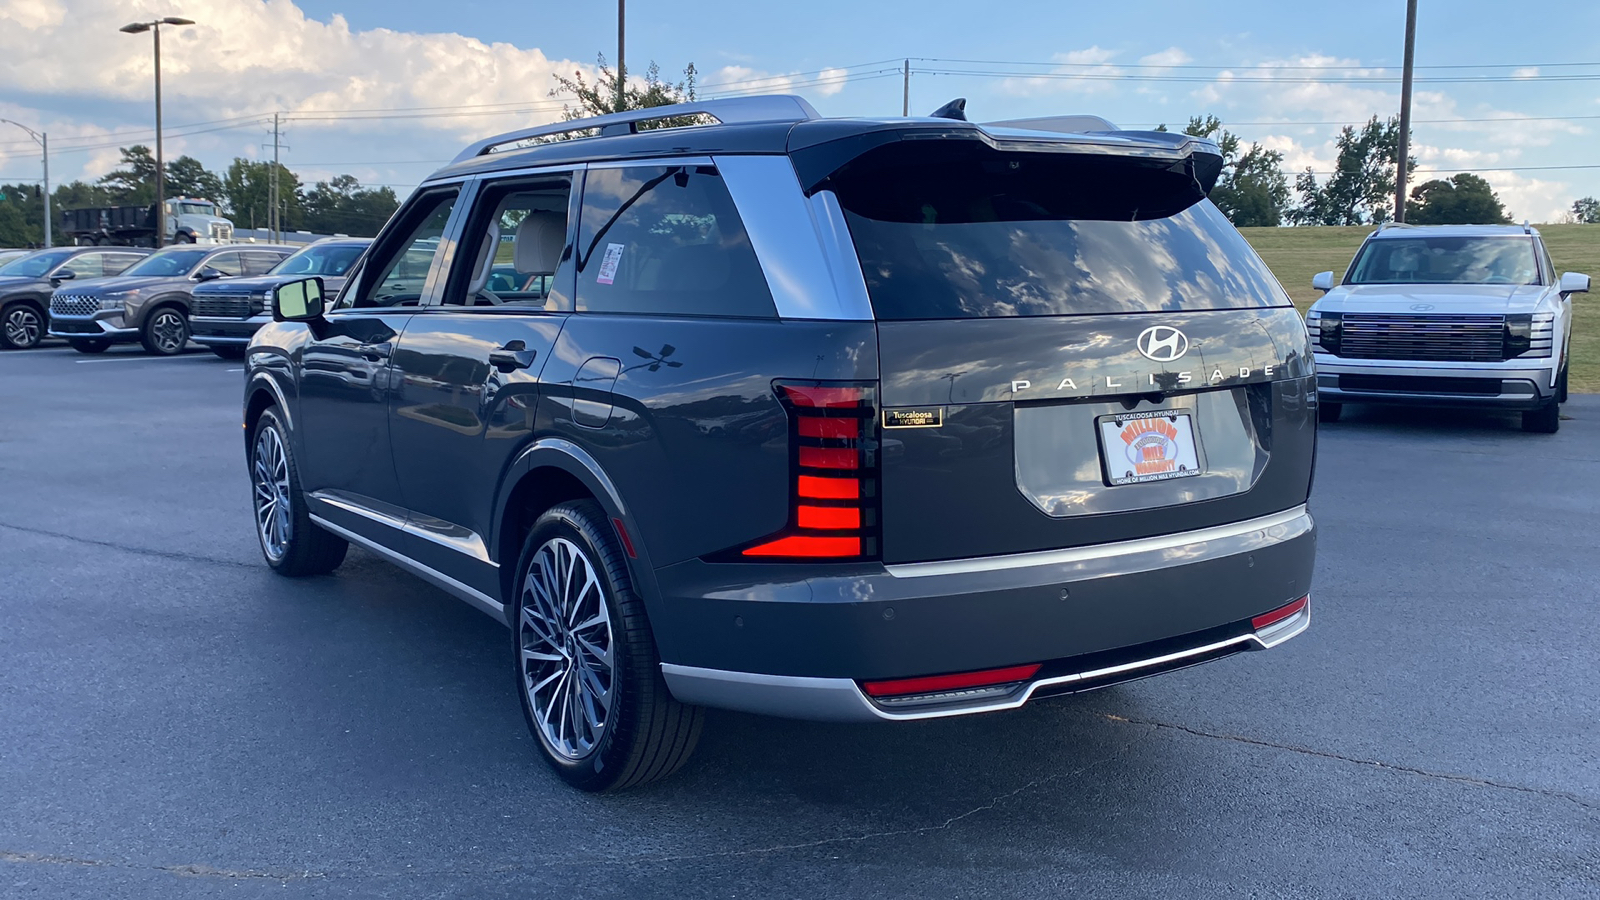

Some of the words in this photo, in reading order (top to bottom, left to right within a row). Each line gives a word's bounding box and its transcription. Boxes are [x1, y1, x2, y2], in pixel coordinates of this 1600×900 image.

[1010, 364, 1275, 393] PALISADE
[893, 411, 932, 419] Tuscaloosa
[1115, 412, 1153, 421] TUSCALOOSA
[1120, 418, 1178, 446] MILLION
[1142, 445, 1165, 461] MILE
[1135, 459, 1176, 475] WARRANTY
